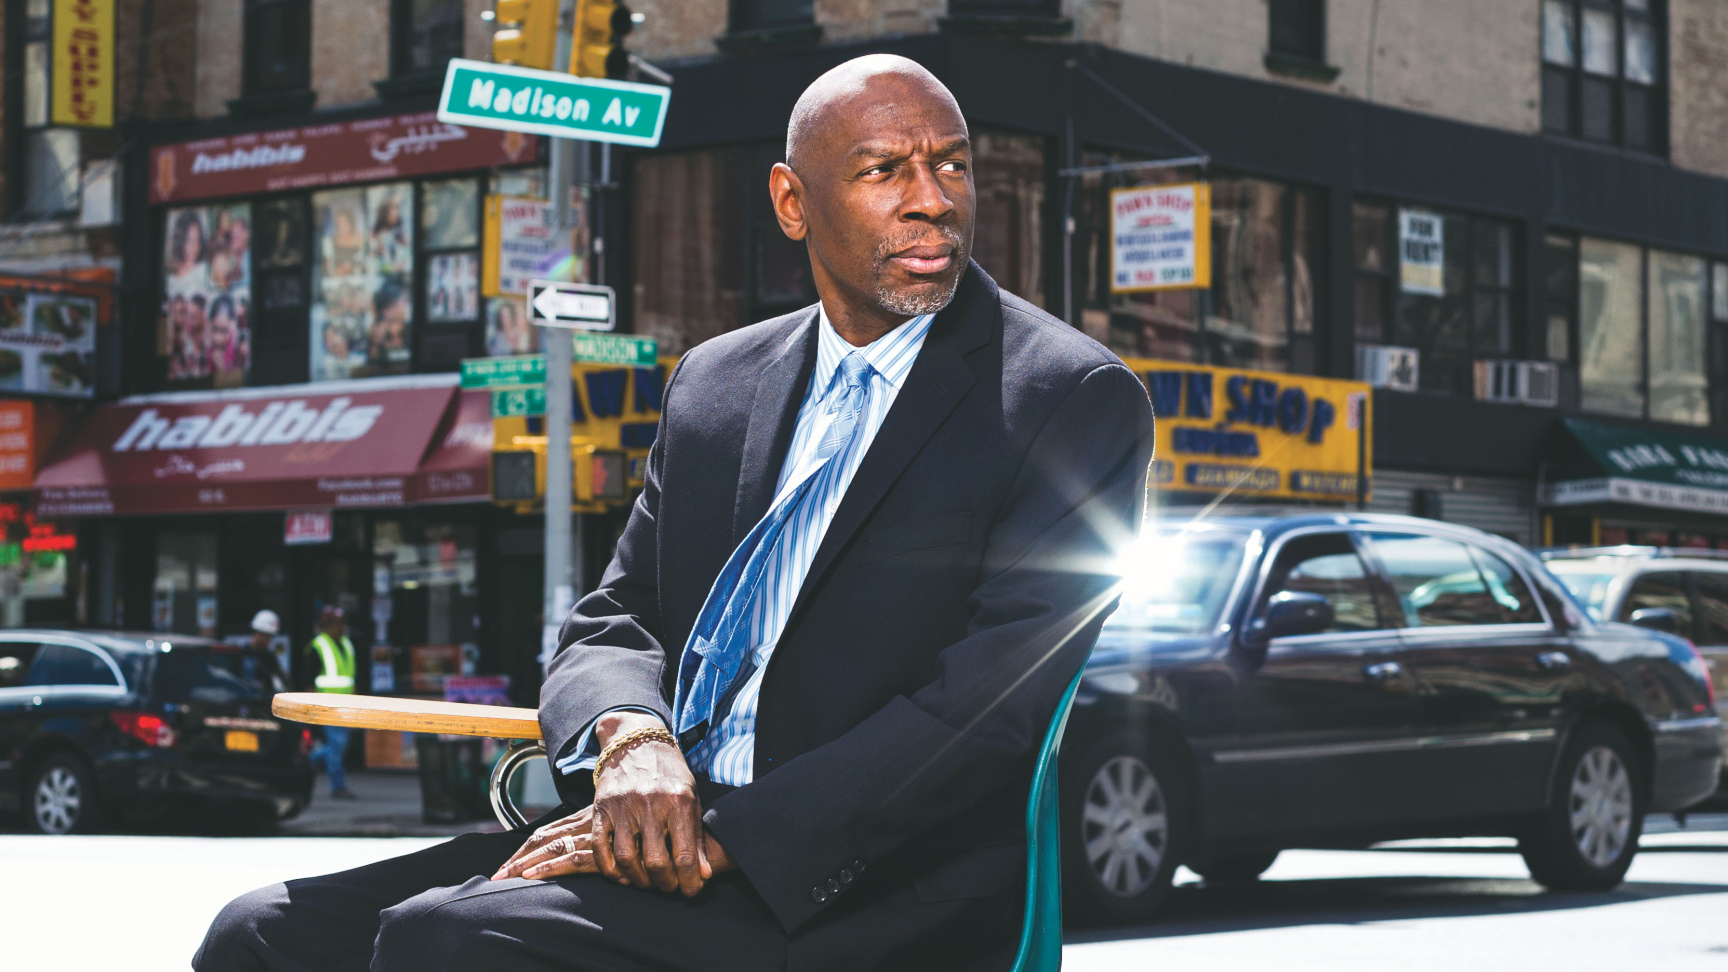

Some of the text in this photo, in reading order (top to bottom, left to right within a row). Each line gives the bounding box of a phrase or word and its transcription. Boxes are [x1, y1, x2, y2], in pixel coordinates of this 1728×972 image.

[468, 78, 641, 128] Madison Av
[191, 142, 306, 175] habibis
[1116, 193, 1193, 218] PAWN SHOP
[1409, 217, 1432, 237] FOR
[1405, 239, 1439, 263] RENT
[573, 338, 639, 363] MADISON
[114, 396, 384, 452] habibis
[1226, 375, 1336, 445] SHOP
